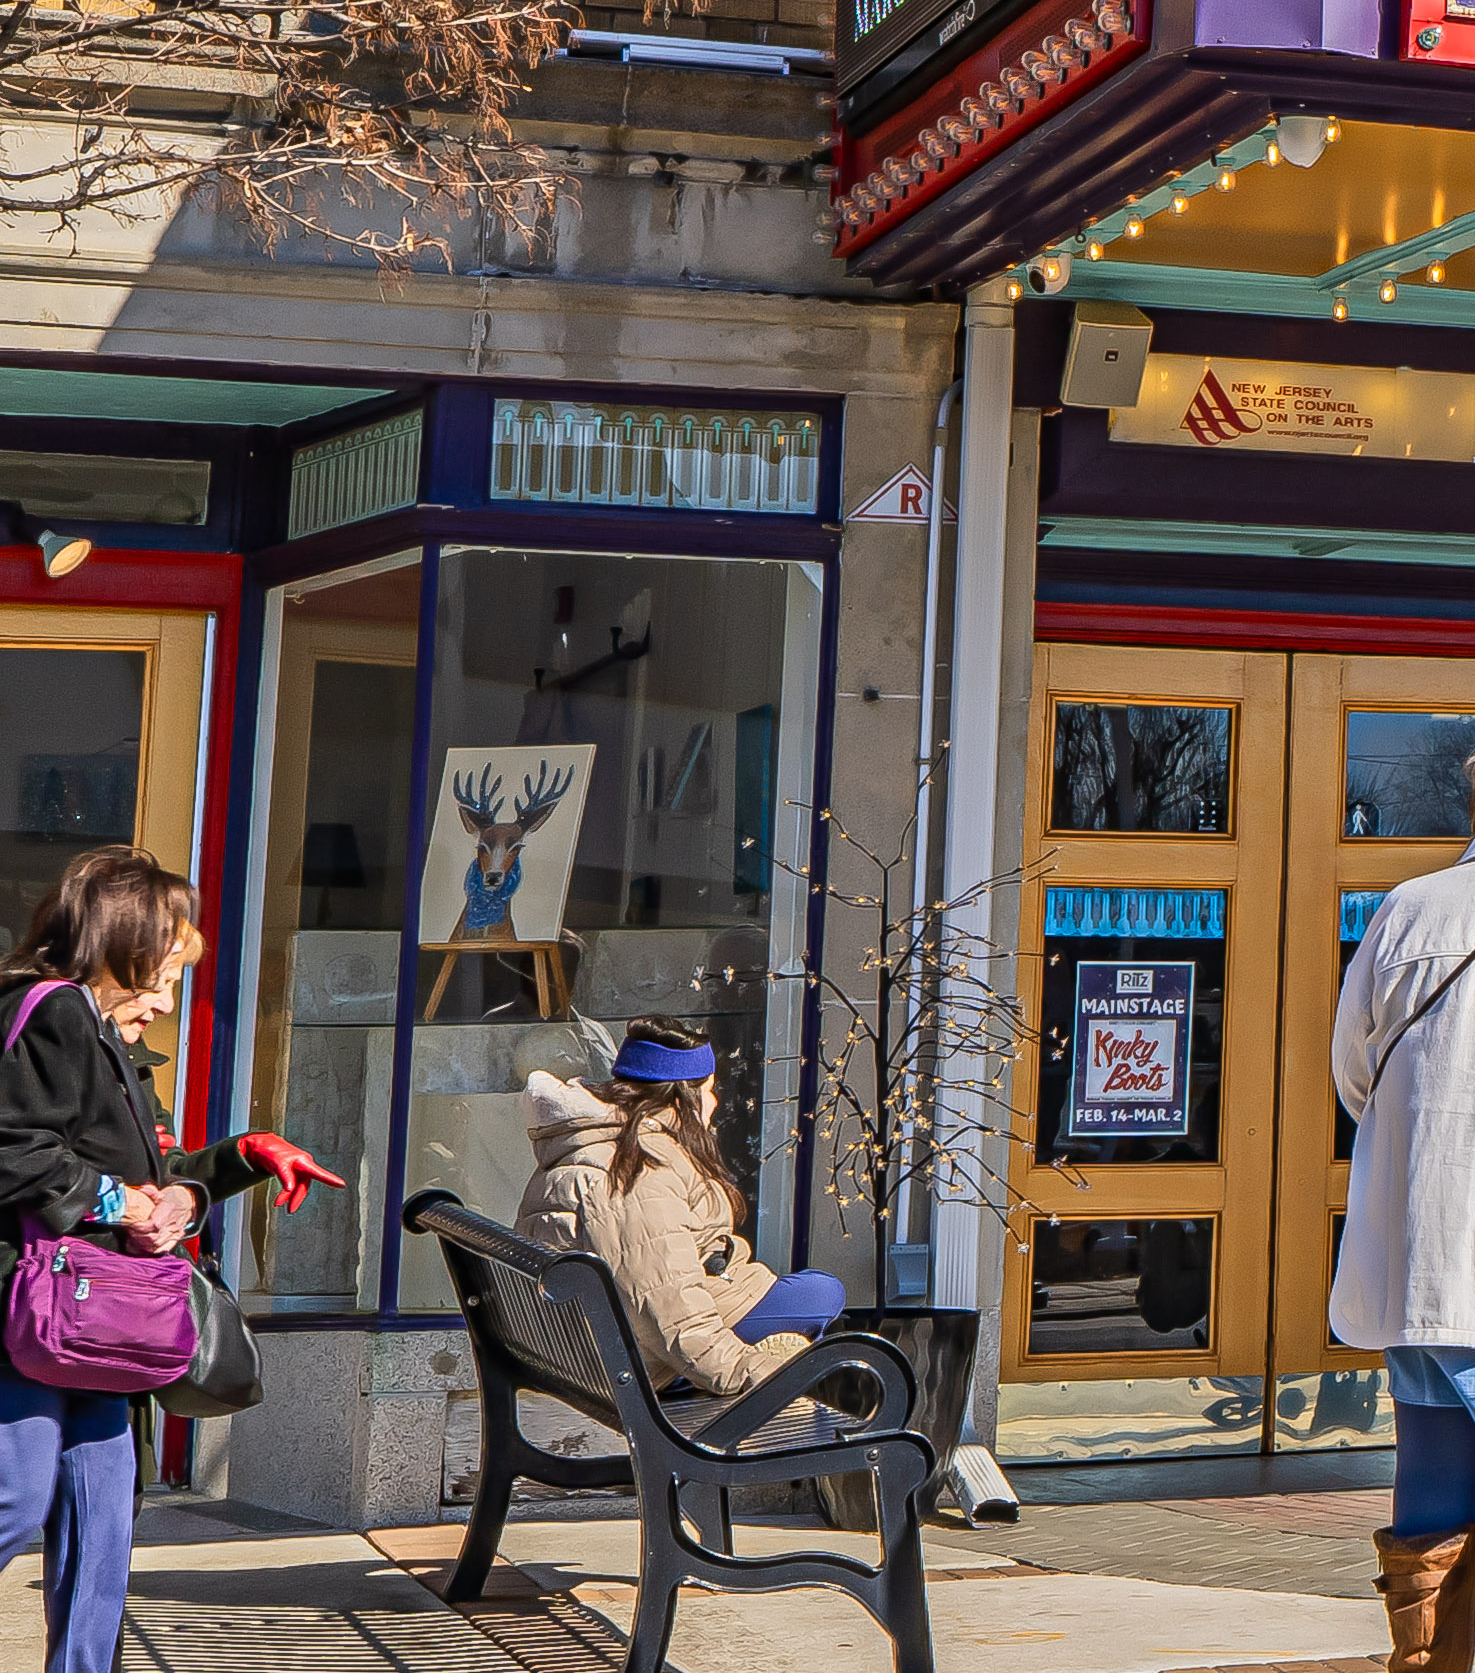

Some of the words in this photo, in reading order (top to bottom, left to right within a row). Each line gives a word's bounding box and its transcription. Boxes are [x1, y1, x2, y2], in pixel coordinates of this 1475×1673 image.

[1231, 383, 1267, 395] NEW
[1274, 385, 1333, 399] JERSEY
[1240, 397, 1286, 410] STATE
[1294, 400, 1360, 415] COUNCIL
[1266, 412, 1289, 424] ON
[1296, 414, 1325, 426] THE
[1333, 417, 1374, 429] ARTS
[900, 483, 923, 515] R
[1081, 997, 1185, 1015] MAINSTAGE
[1093, 1029, 1160, 1068] Kinky
[1102, 1063, 1170, 1094] Boots
[1076, 1109, 1107, 1123] FEB.
[1173, 1110, 1183, 1122] 2
